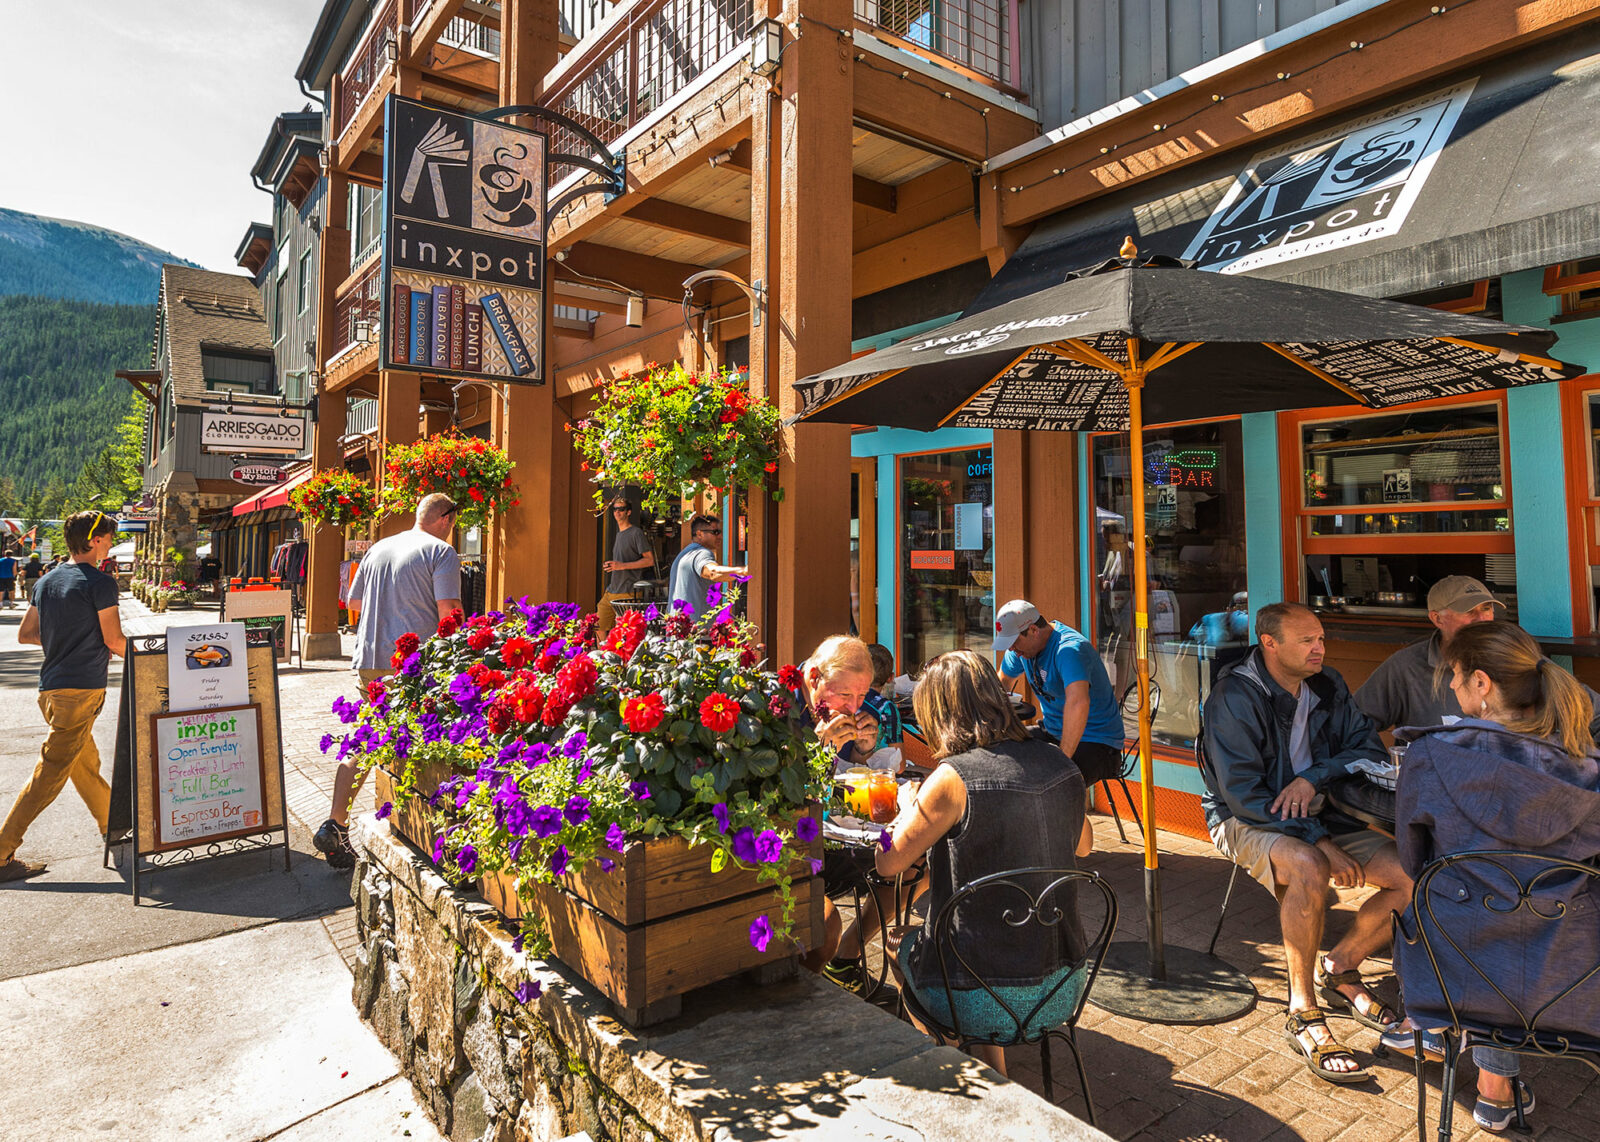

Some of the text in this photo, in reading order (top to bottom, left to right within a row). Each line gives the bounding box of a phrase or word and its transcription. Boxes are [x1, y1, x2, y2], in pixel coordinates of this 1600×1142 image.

[1197, 192, 1391, 262] inxpot
[400, 224, 536, 280] inxpot
[1278, 226, 1384, 258] colorado
[398, 293, 408, 358] BAKED GOODS
[416, 298, 425, 362] BOOKSTORE
[437, 294, 446, 361] LIBATIONS
[453, 288, 463, 366] ESPRESSO BAR
[468, 311, 479, 365] LUNCH
[488, 297, 530, 372] BREAKFAST
[1492, 365, 1522, 375] Old
[206, 420, 300, 436] ARRIESGADO
[956, 414, 1026, 426] Tennessee
[1170, 468, 1213, 487] BAR
[913, 556, 952, 564] BOOKSTORE
[188, 632, 229, 642] SUSHI
[176, 716, 237, 740] inxpot
[168, 741, 238, 762] Open Everyday
[182, 774, 232, 794] Full Bar
[172, 800, 244, 826] Espresso Bar
[174, 826, 194, 838] Coffee
[200, 824, 213, 834] Tea
